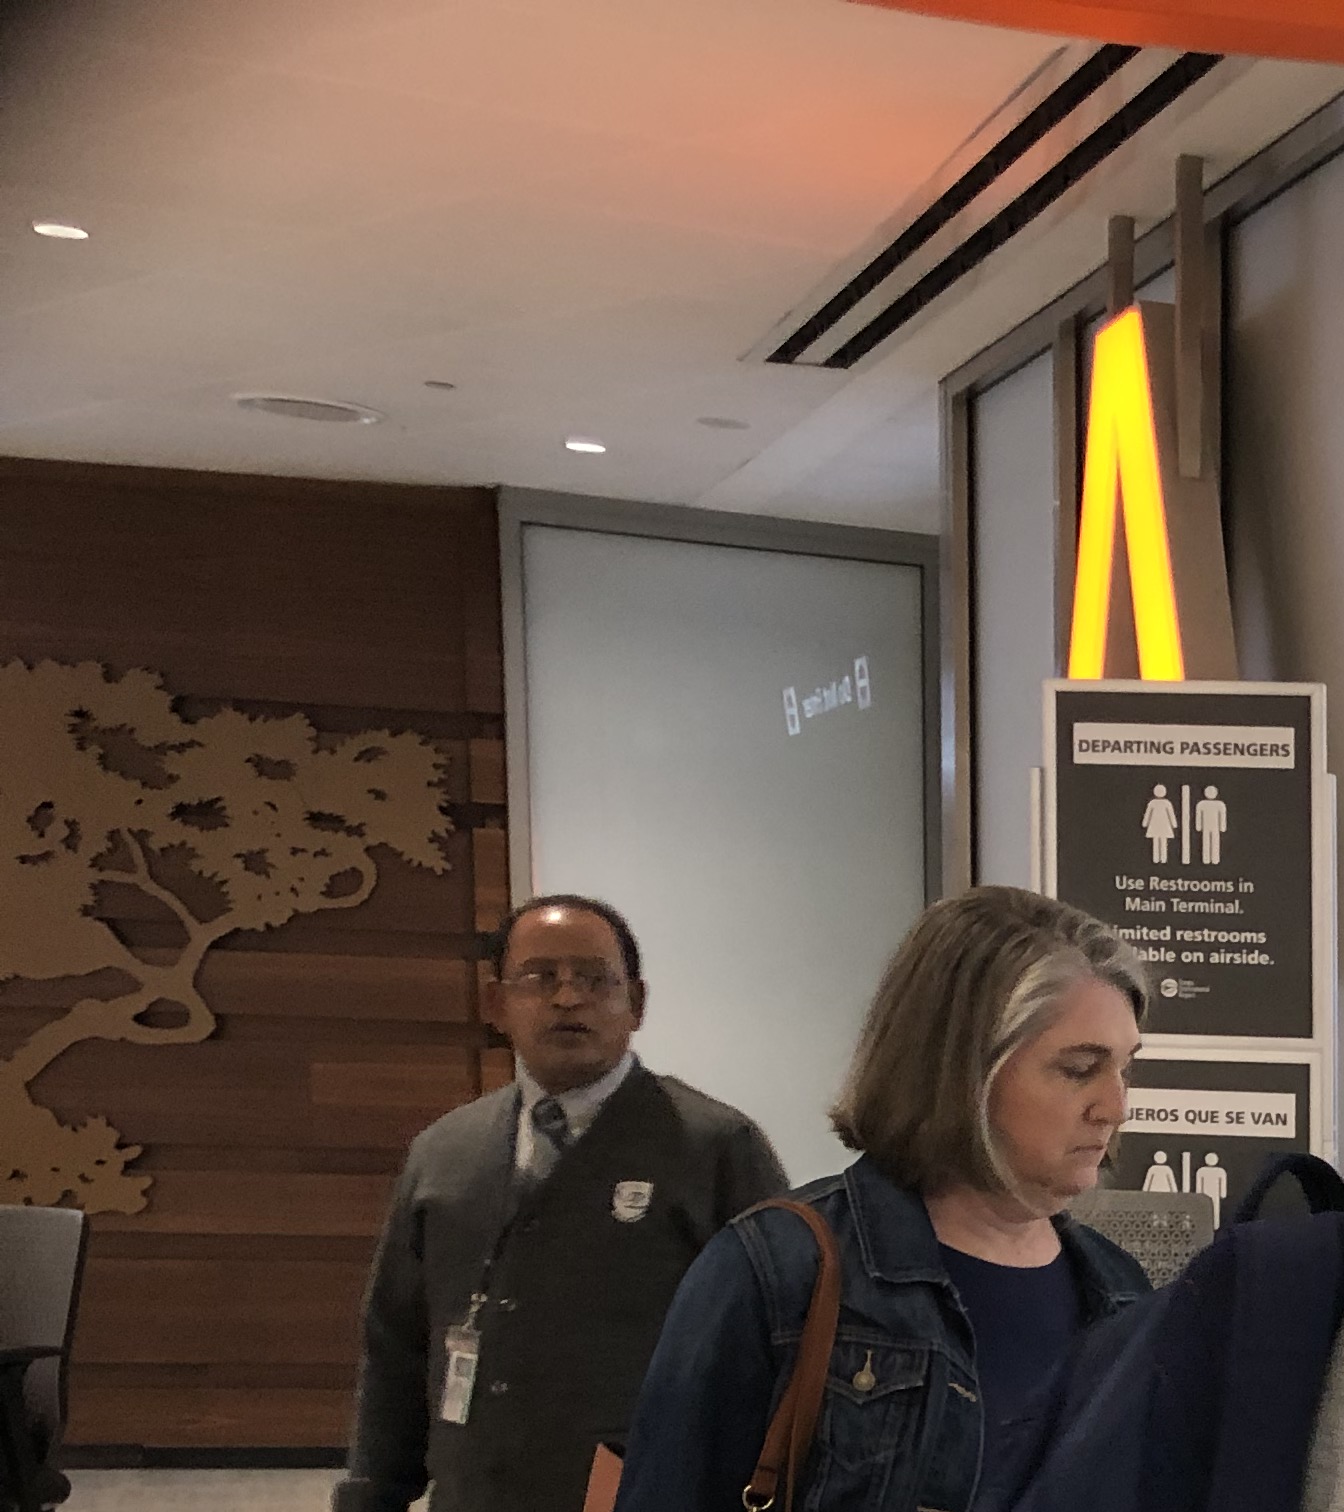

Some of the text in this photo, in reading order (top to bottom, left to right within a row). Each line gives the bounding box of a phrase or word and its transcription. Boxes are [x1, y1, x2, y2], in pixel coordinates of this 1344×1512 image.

[1077, 738, 1291, 758] DEPARTING PASSENGERS
[1115, 875, 1255, 894] Use Restrooms in
[1125, 896, 1245, 915] Main Terminal.
[1112, 924, 1267, 944] imited restrooms
[1180, 950, 1204, 963] on
[1208, 949, 1275, 966] airside.
[1127, 1107, 1288, 1127] JEROS QUE SE VAN
